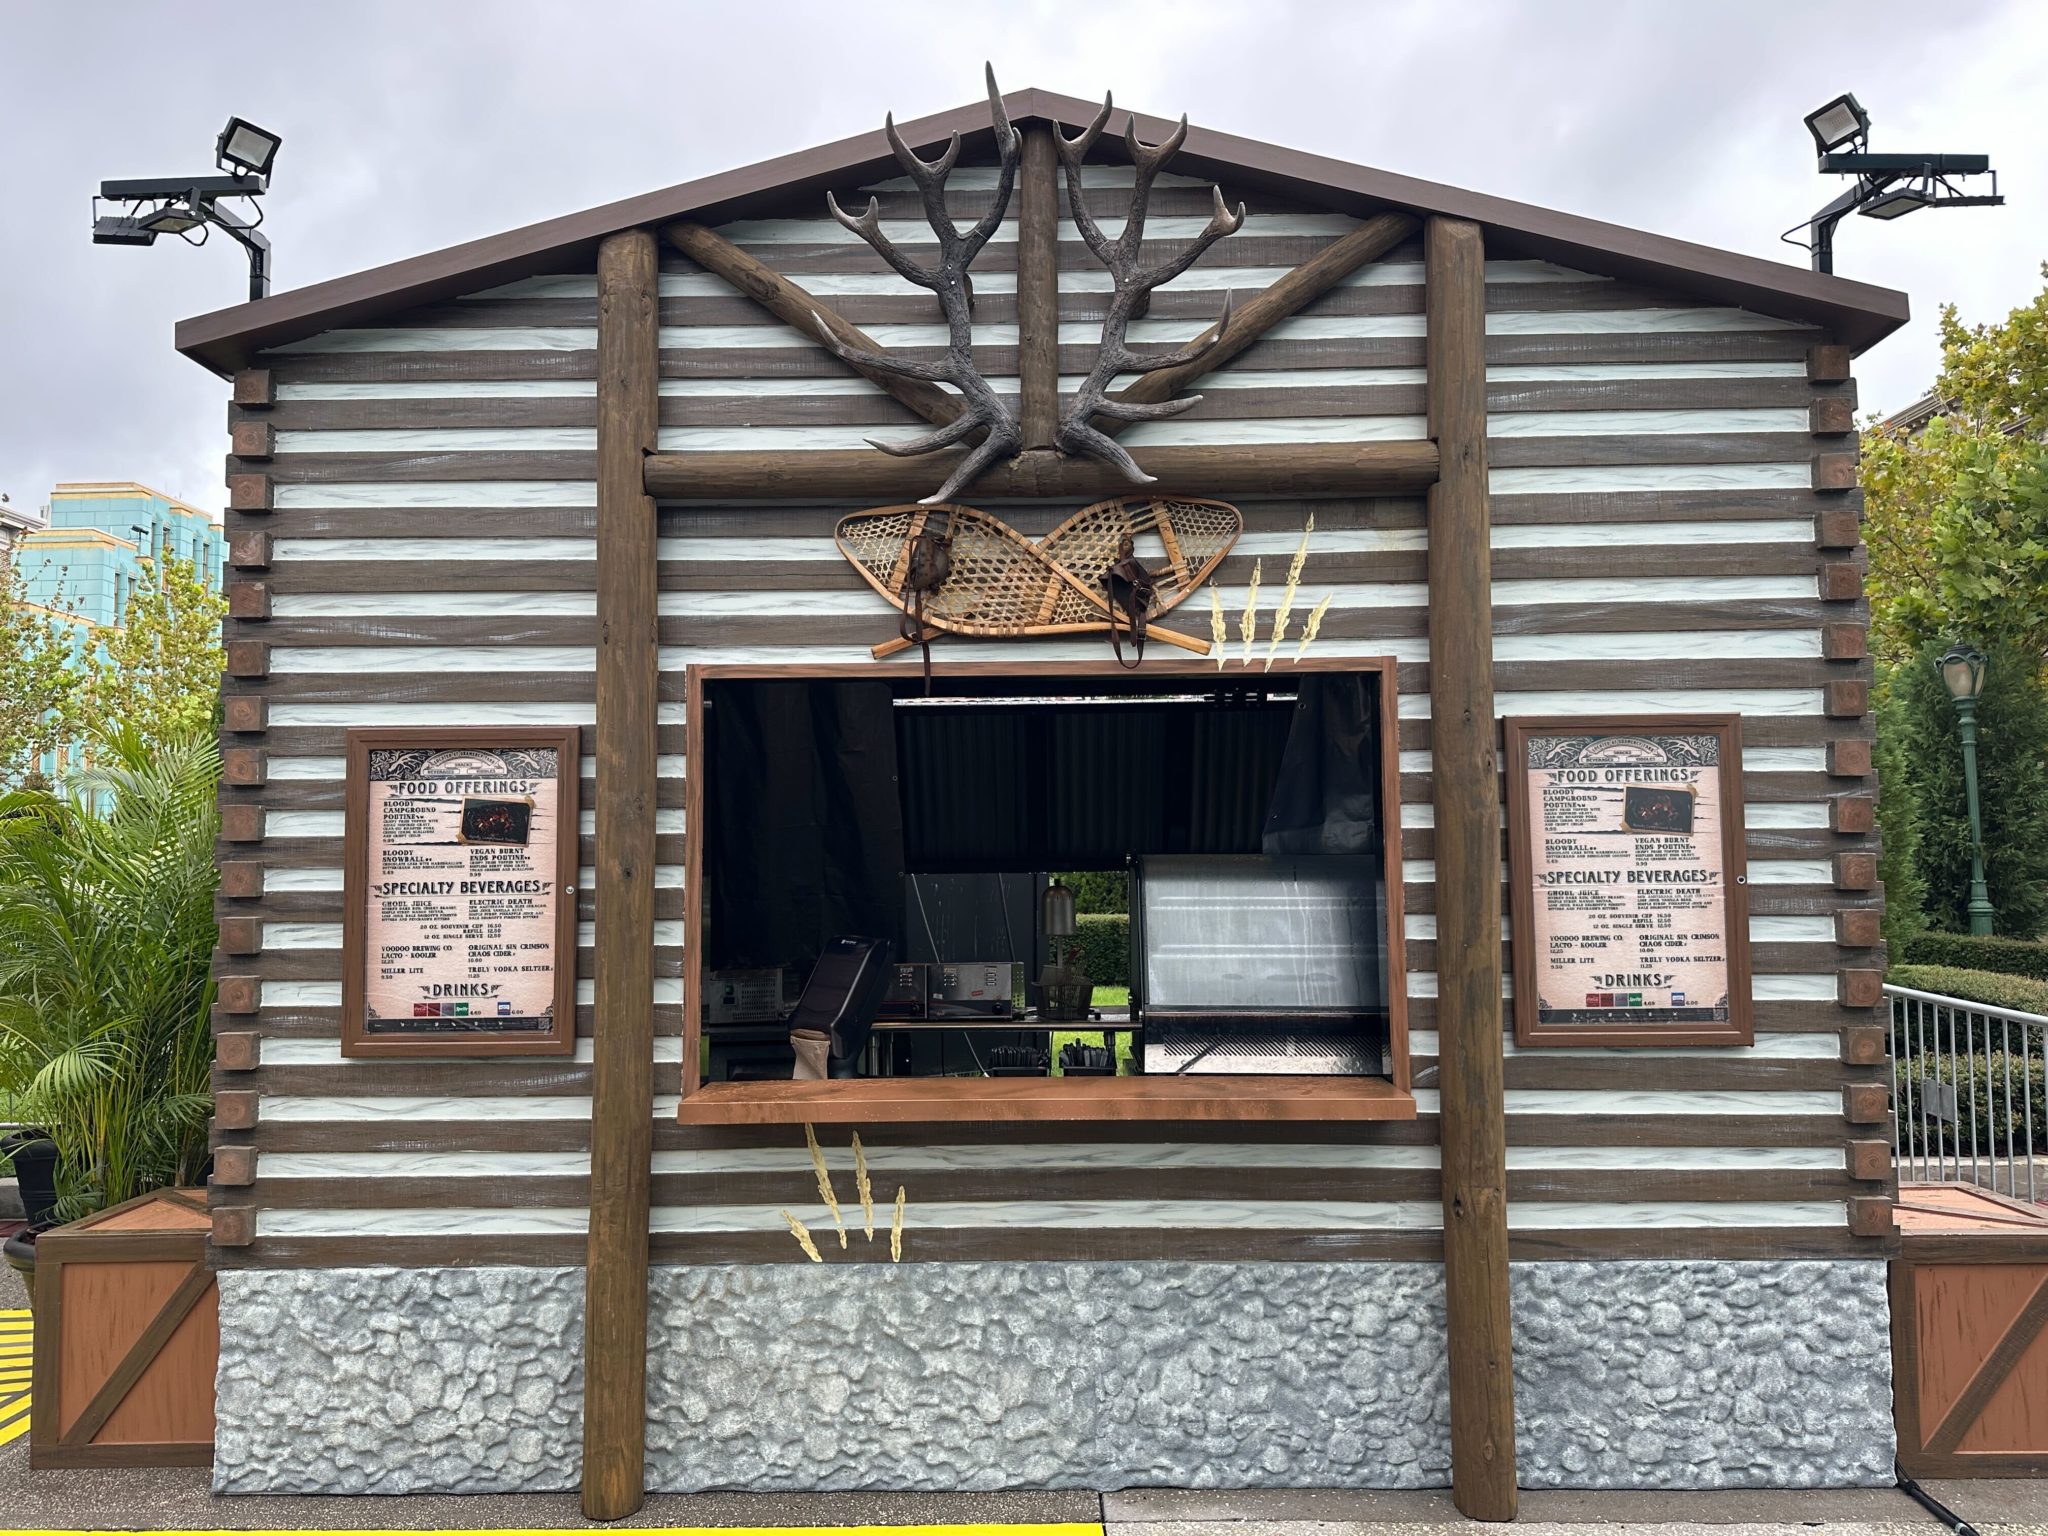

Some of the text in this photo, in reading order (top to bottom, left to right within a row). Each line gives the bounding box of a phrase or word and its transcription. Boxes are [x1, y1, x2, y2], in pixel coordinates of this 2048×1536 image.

[1557, 769, 1688, 783] FOOD OFFERINGS
[399, 781, 527, 794] FOOD OFFERINGS
[1547, 870, 1707, 884] SPECIALTY BEVERAGES
[383, 880, 540, 895] SPECIALTY BEVERAGES
[1605, 974, 1661, 986] DRINKS
[433, 983, 488, 996] DRINKS
